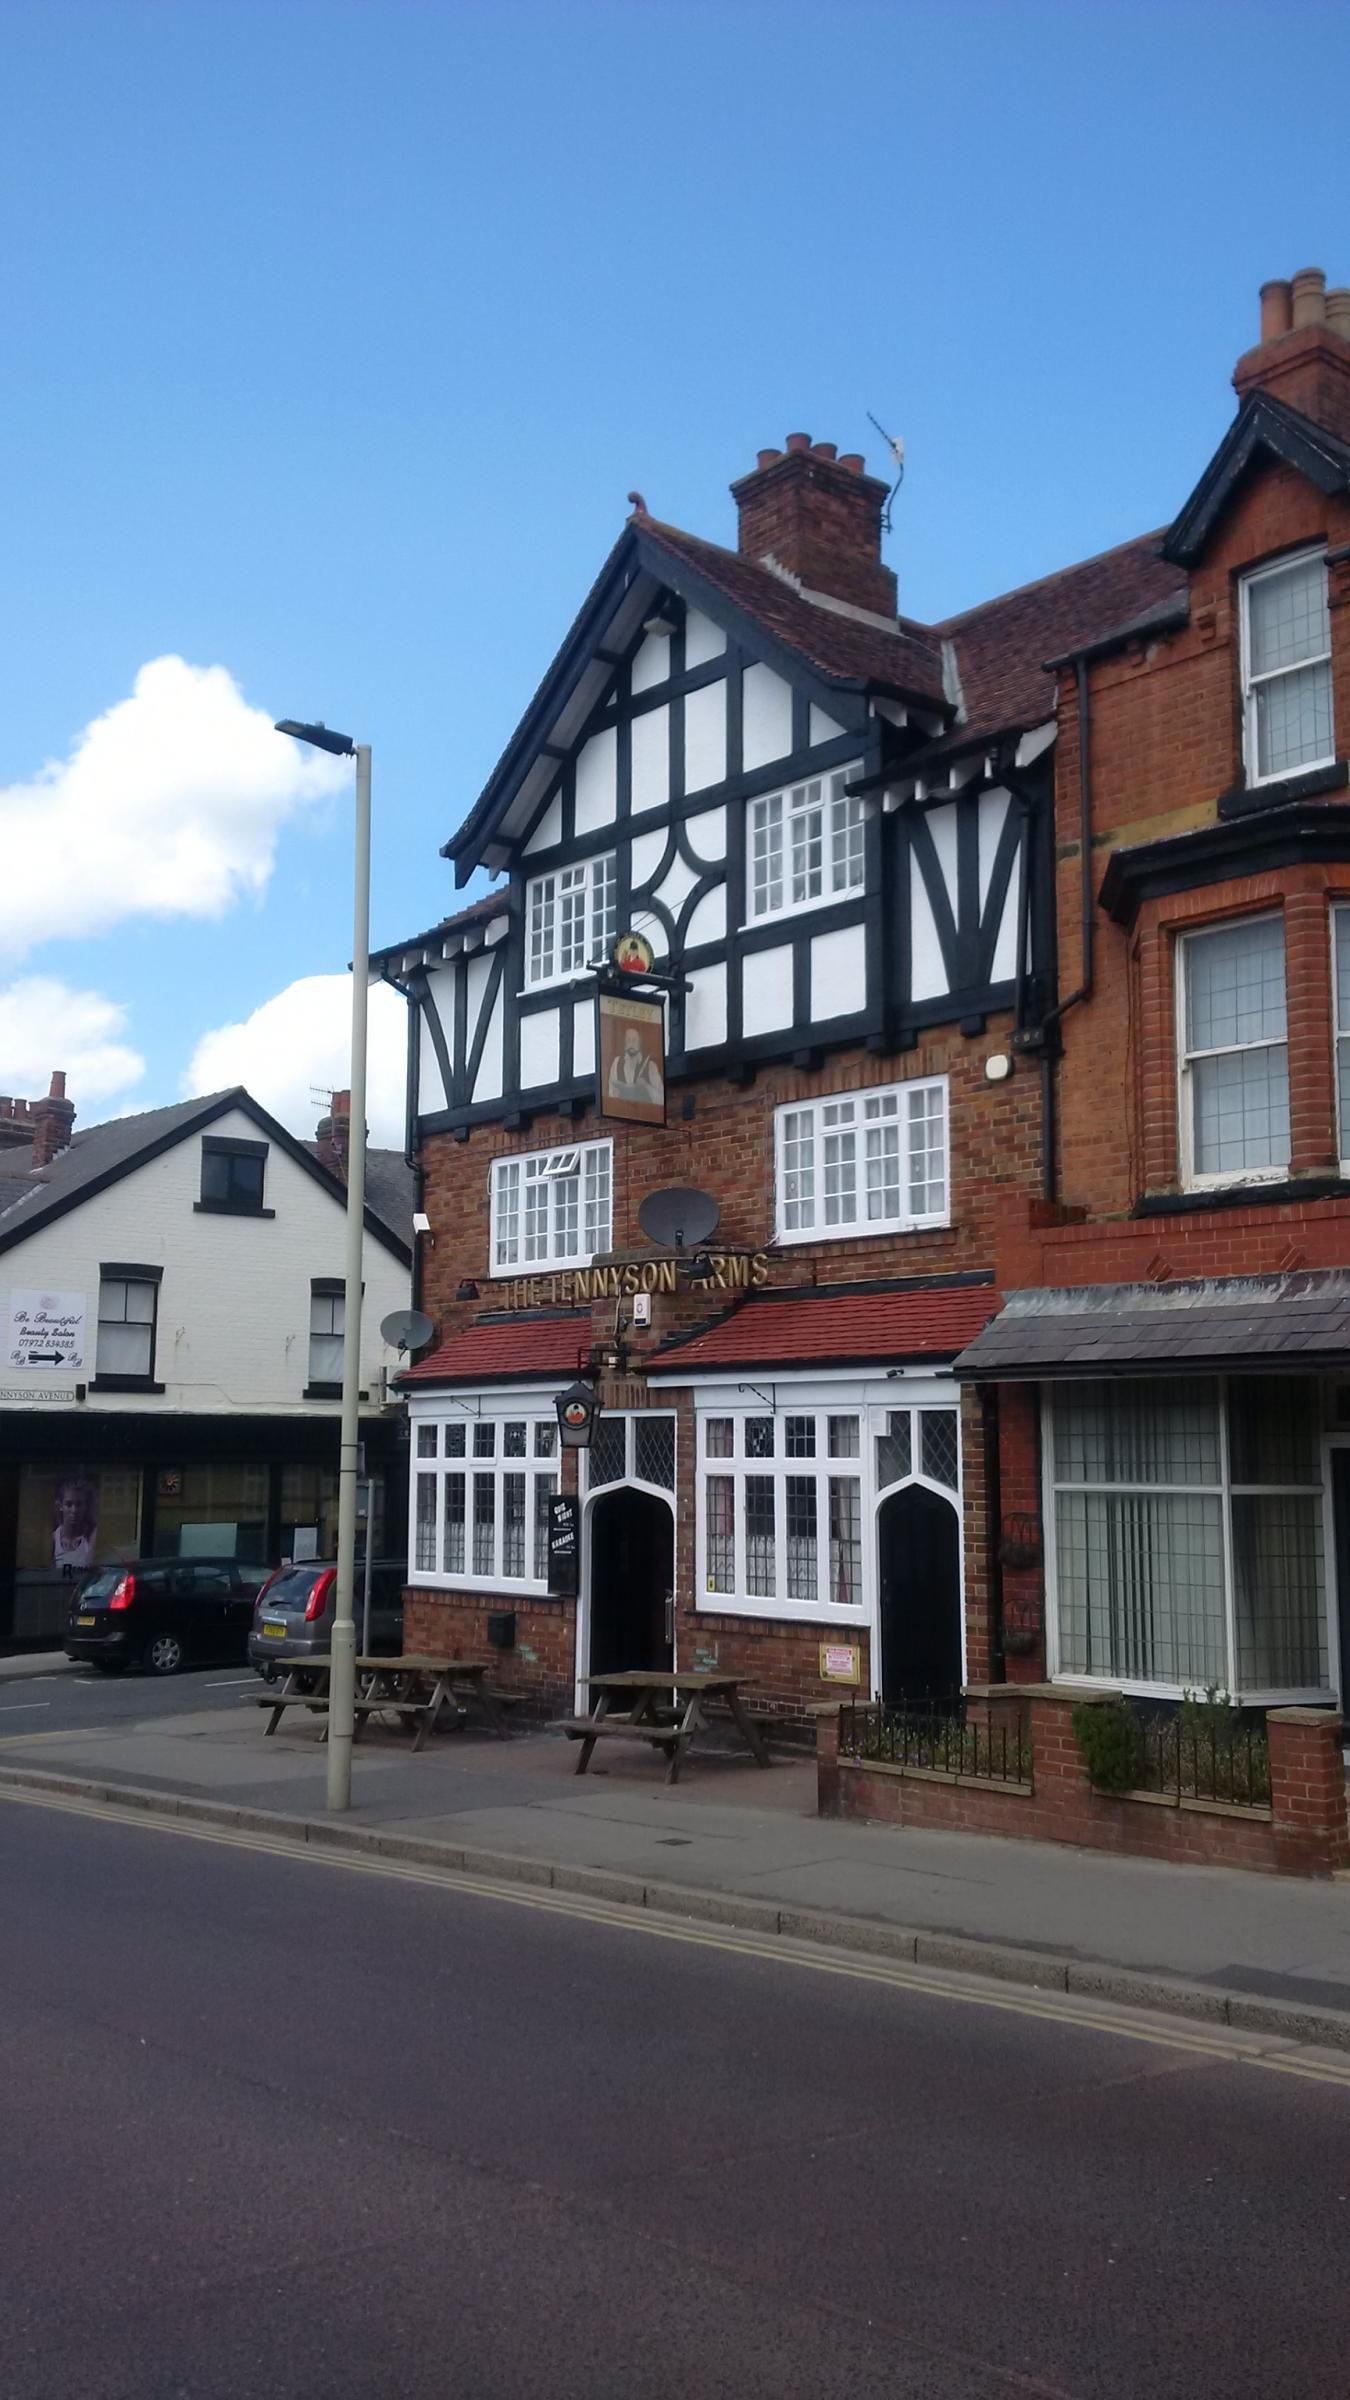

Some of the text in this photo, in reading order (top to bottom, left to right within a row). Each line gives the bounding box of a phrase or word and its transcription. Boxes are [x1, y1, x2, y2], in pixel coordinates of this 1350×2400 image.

[501, 1277, 538, 1309] THE
[552, 1260, 677, 1304] TENNYSON
[14, 1311, 82, 1326] Be Beautiful
[19, 1326, 75, 1339] Beauty Salon
[39, 1391, 71, 1400] AVENUE
[551, 1532, 574, 1549] KARAOKE
